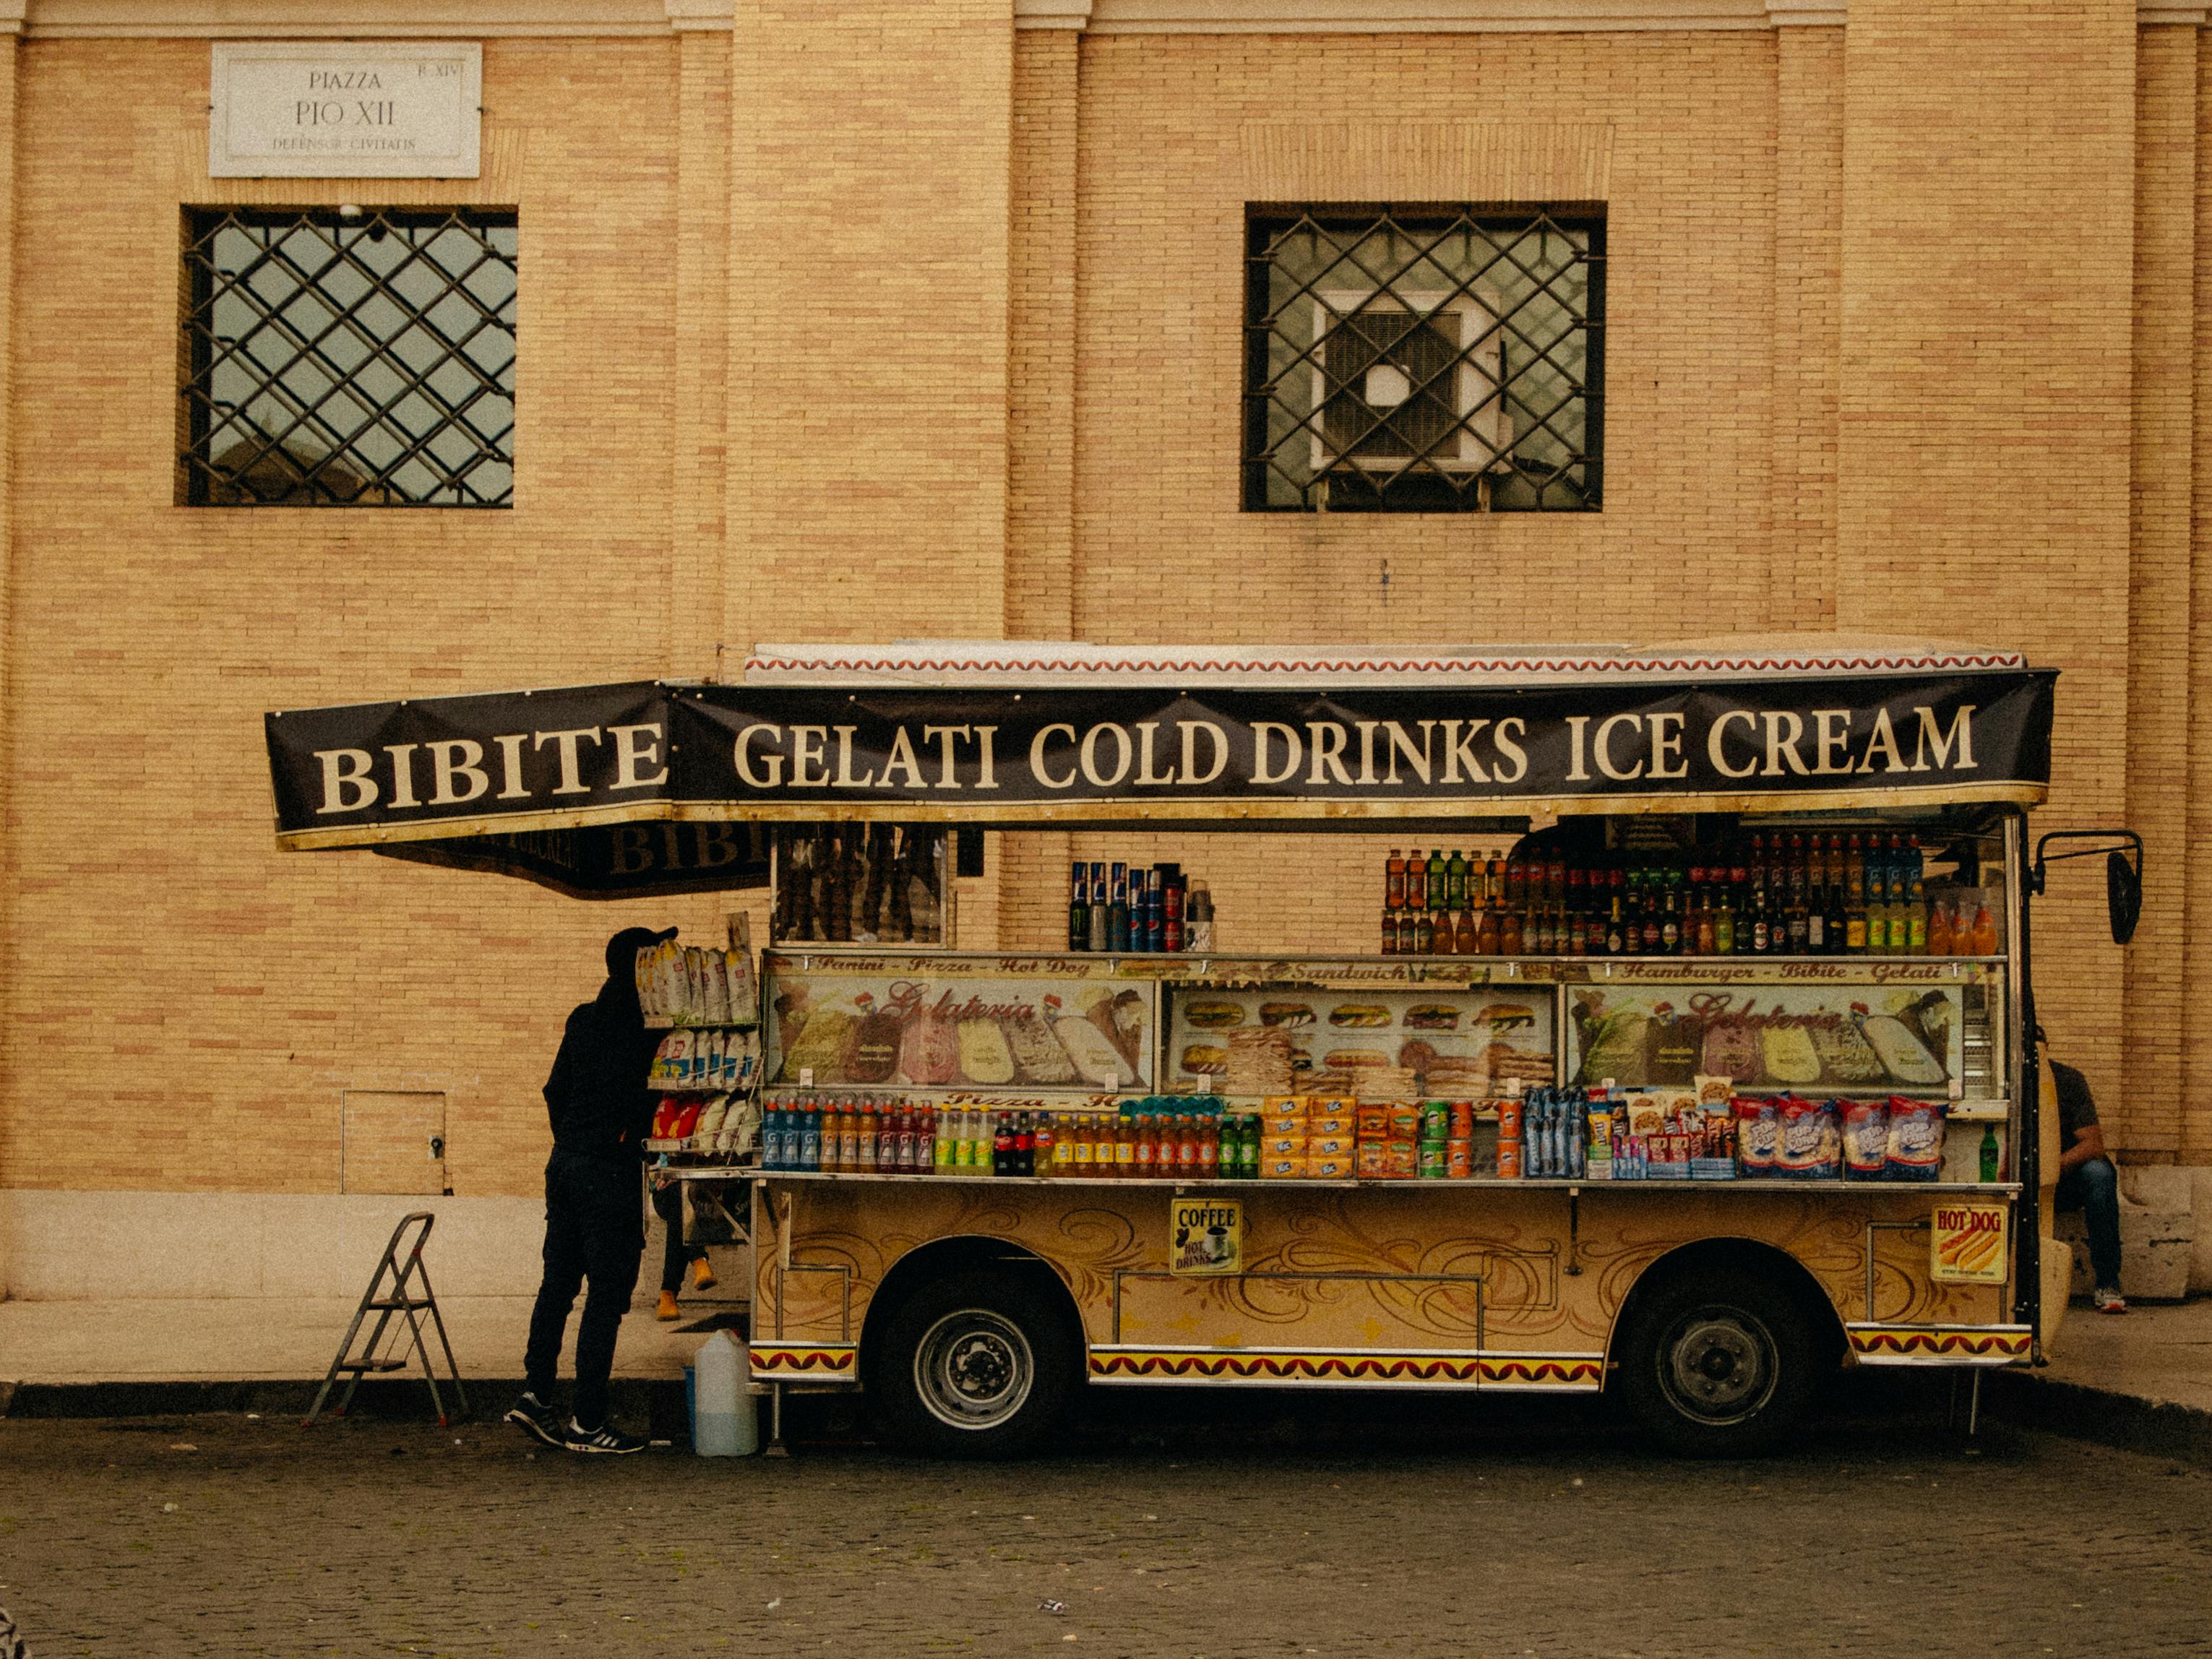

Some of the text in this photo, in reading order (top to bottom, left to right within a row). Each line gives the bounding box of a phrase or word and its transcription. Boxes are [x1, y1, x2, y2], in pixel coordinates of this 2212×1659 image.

[309, 72, 382, 89] PIAZZA
[296, 100, 395, 126] PIO XII
[272, 137, 416, 151] DEFENSOR CIVITATIS
[733, 704, 1979, 788] GELATI COLD DRINKS ICE CREAM
[313, 722, 668, 815] BIBITE
[609, 824, 768, 874] BIBI
[817, 956, 886, 970] Panini
[907, 957, 973, 972] Pizza
[996, 959, 1039, 973] Hot
[1046, 959, 1091, 978] Dog
[1291, 962, 1406, 980] Sandwich
[1619, 962, 1756, 983] Hamburger
[1779, 962, 1847, 978] Bibite
[1870, 962, 1942, 983] Gelati
[877, 980, 1036, 1023] Gelateria
[1678, 992, 1842, 1034] Gelateria
[942, 1093, 1047, 1107] Pizza
[1751, 1121, 1776, 1135] POP
[1786, 1125, 1812, 1139] POP
[805, 1133, 814, 1144] G
[920, 1136, 929, 1147] G
[1755, 1132, 1776, 1147] COR
[1179, 1208, 1236, 1227] COFFEE
[1937, 1210, 2002, 1232] HOT DOG
